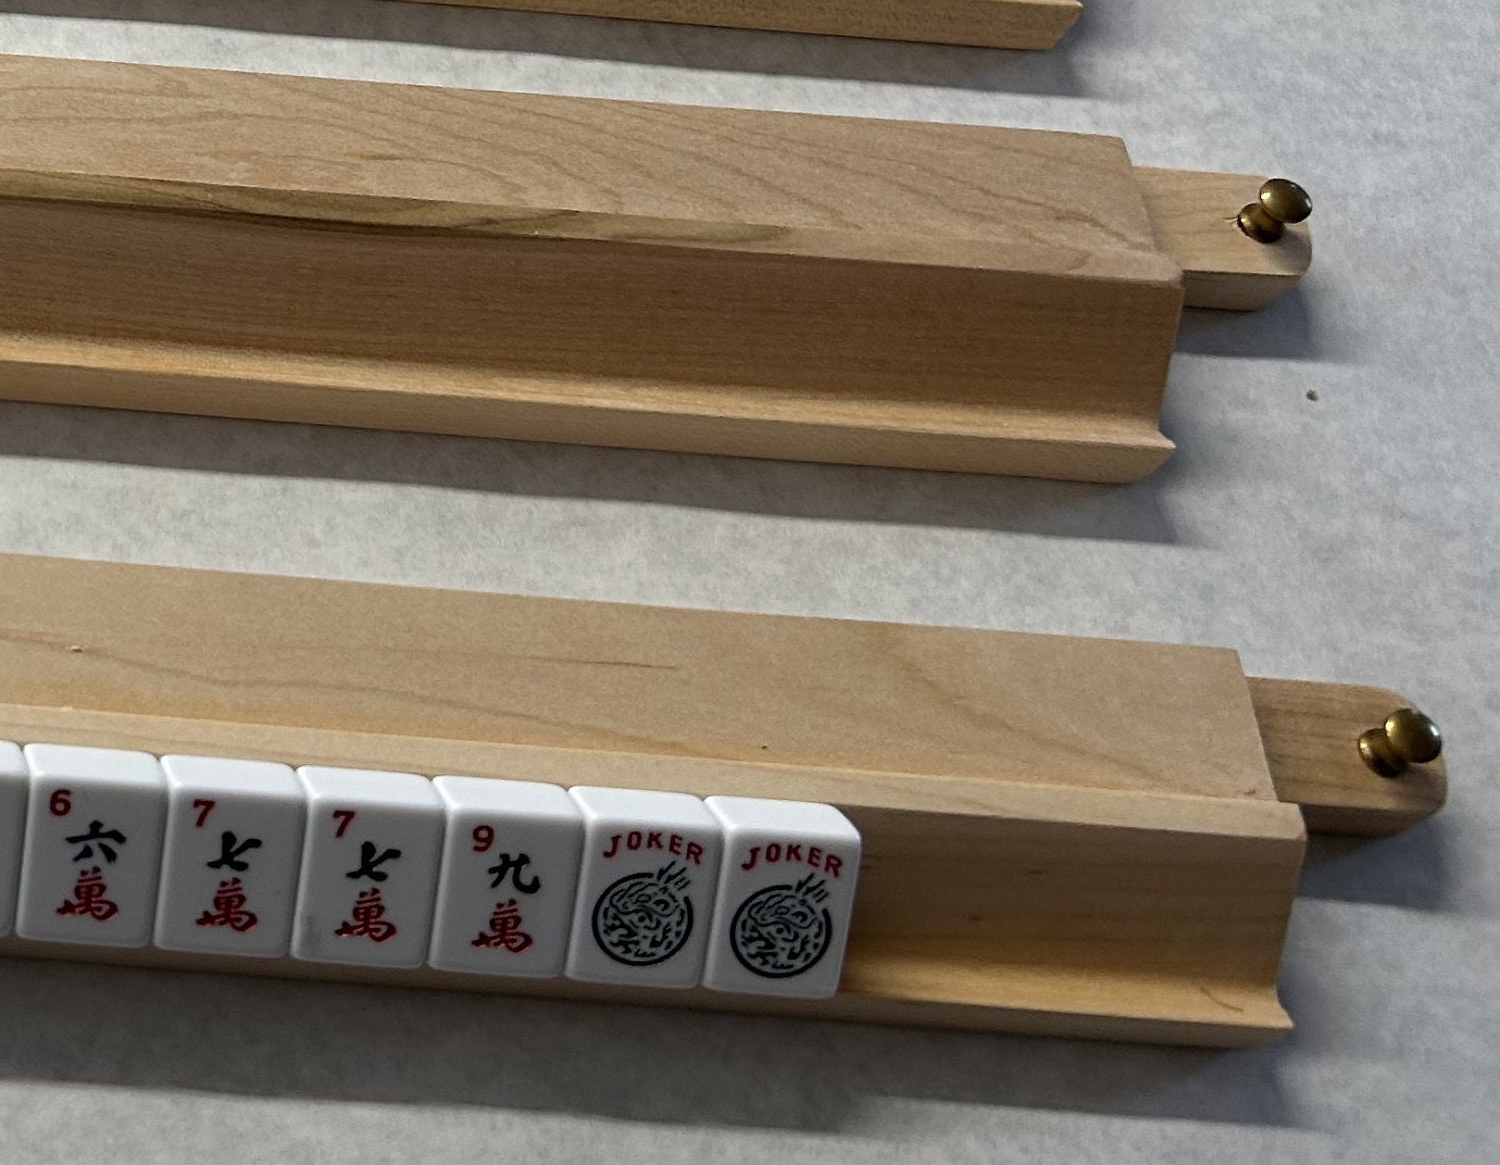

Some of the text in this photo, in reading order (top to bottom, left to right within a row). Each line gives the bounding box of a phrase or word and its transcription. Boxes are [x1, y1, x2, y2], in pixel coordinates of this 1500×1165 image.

[47, 787, 74, 819] 6
[192, 797, 217, 829] 7
[331, 808, 358, 841] 7
[472, 824, 498, 856] 9
[602, 828, 706, 867] JOKER
[743, 841, 844, 880] JOKER
